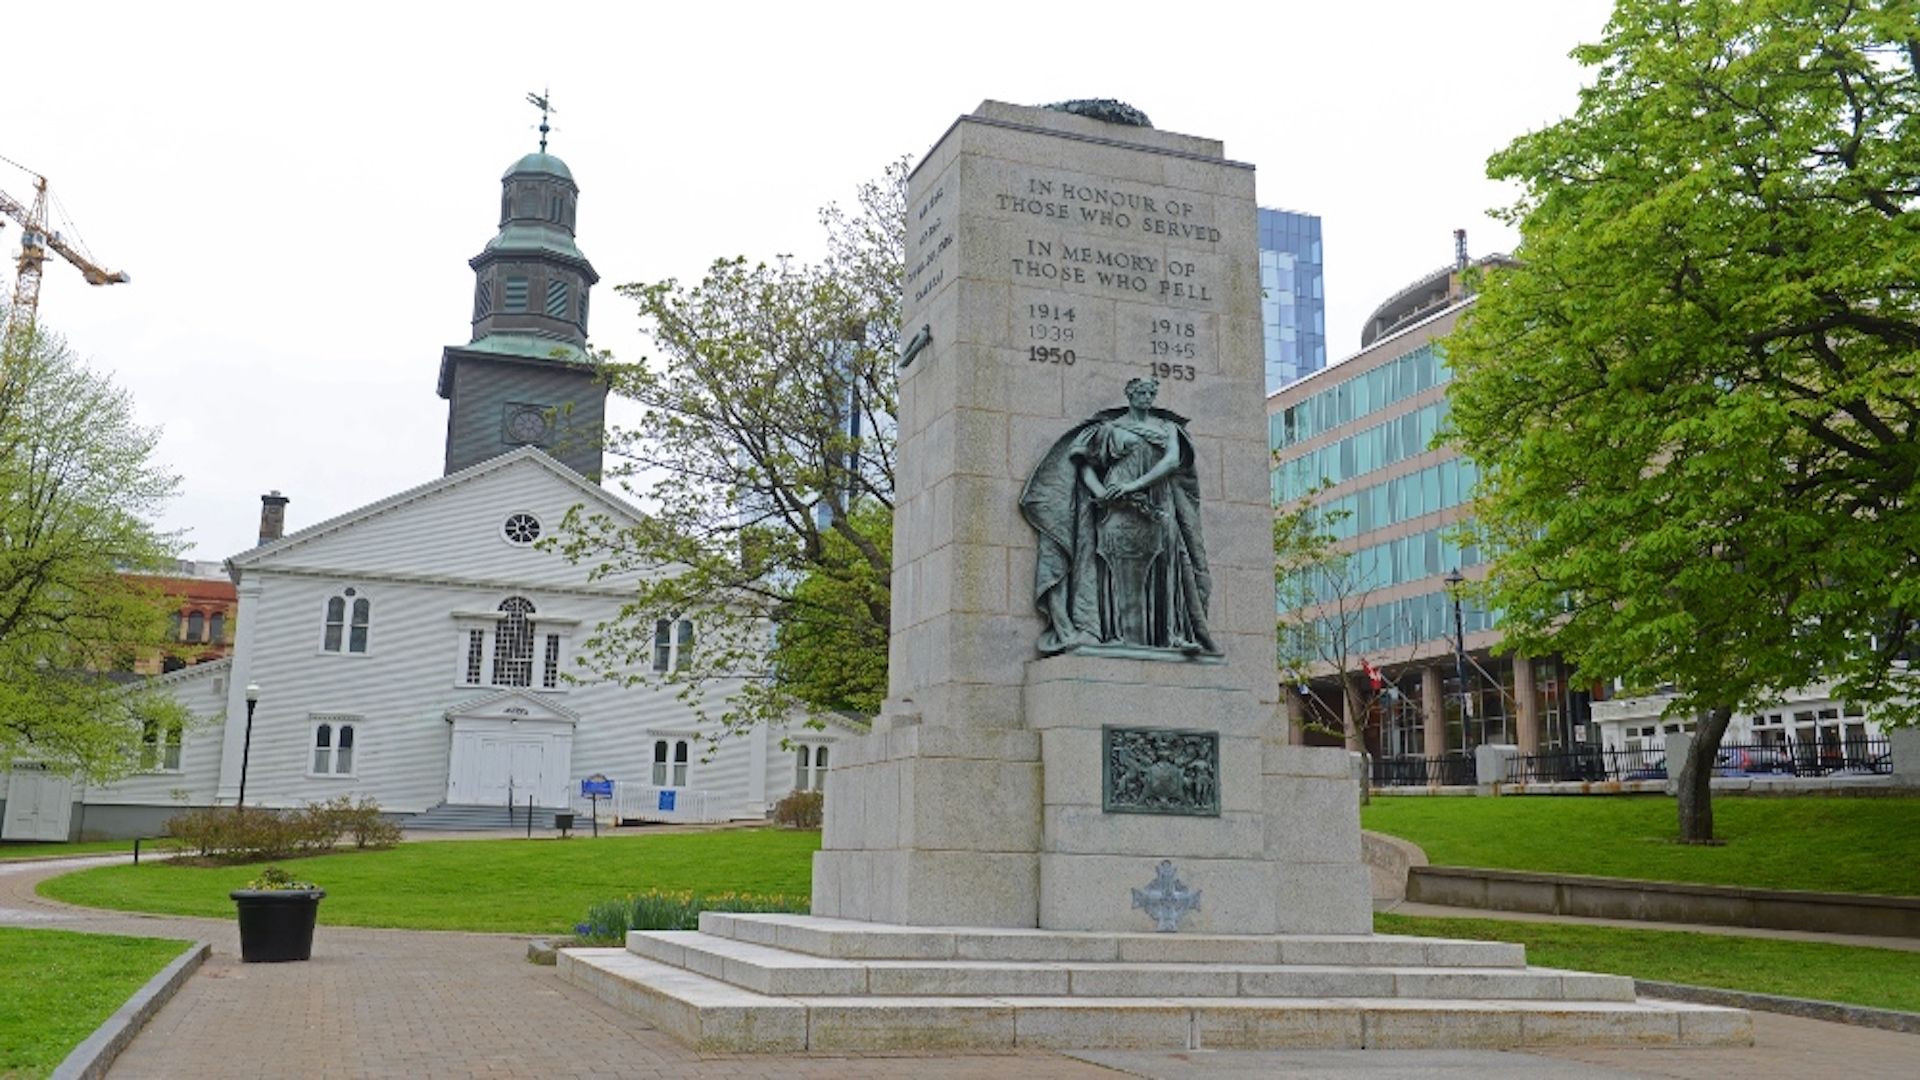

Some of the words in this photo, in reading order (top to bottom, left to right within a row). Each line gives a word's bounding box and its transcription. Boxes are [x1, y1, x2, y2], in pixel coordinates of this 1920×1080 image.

[1029, 178, 1052, 195] IN
[1063, 183, 1156, 212] HONOUR
[1165, 200, 1193, 215] OF
[996, 194, 1070, 219] THOSE
[1080, 206, 1131, 228] WHO
[1142, 217, 1221, 243] SERVED
[1027, 239, 1052, 256] IN
[1063, 245, 1159, 272] MEMORY
[1168, 261, 1196, 277] OF
[1011, 259, 1085, 284] THOSE
[1097, 272, 1147, 292] WHO
[1159, 280, 1212, 301] FELL
[1029, 304, 1076, 321] 1914
[1029, 323, 1074, 341] 1939
[1151, 320, 1195, 337] 1918
[1029, 346, 1076, 366] 1950
[1150, 340, 1195, 359] 1945
[1150, 362, 1195, 382] 1953
